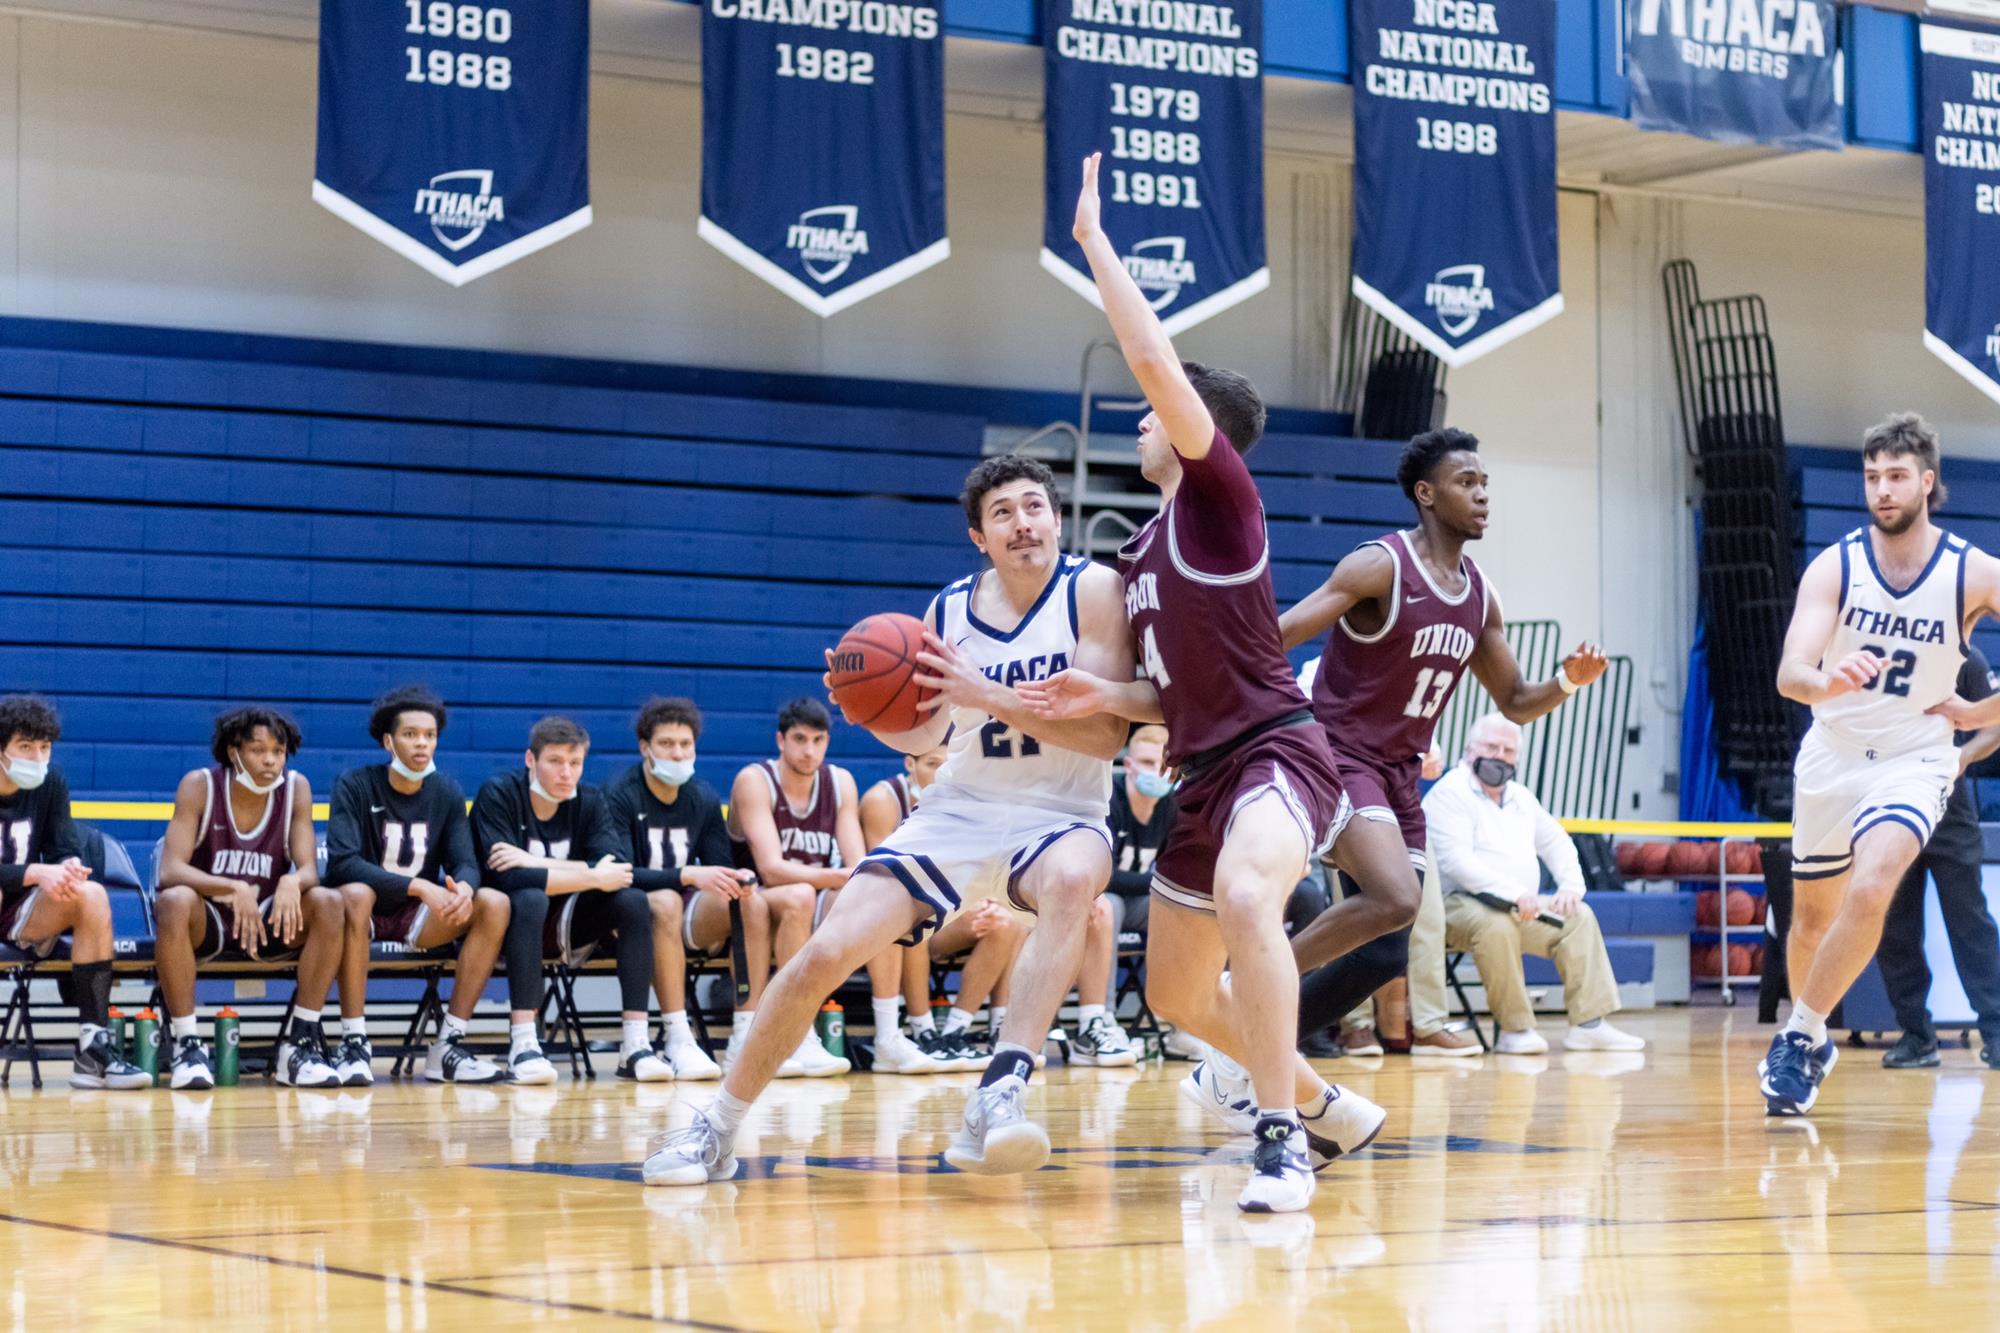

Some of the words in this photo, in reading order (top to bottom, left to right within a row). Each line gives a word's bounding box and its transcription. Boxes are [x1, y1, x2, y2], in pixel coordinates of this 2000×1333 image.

[405, 0, 512, 43] 1980
[711, 0, 938, 40] CHAMPIONS
[1071, 0, 1241, 39] NATIONAL
[1413, 0, 1499, 35] NCGA
[1638, 0, 1826, 57] ITHACA
[405, 46, 512, 91] 1988
[776, 43, 875, 85] 1982
[1057, 26, 1259, 78] CHAMPIONS
[1378, 28, 1535, 75] NATIONAL
[1110, 82, 1201, 122] 1979
[1366, 64, 1550, 114] CHAMPIONS
[1110, 126, 1201, 165] 1988
[1416, 116, 1498, 156] 1998
[413, 188, 505, 222] ITHACA
[1111, 169, 1201, 208] 1991
[786, 224, 869, 255] ITHACA
[1845, 606, 1945, 645] ITHACA
[979, 652, 1069, 689] HACA
[1143, 622, 1173, 690] 4
[1402, 666, 1454, 719] 13
[211, 849, 273, 880] UNION
